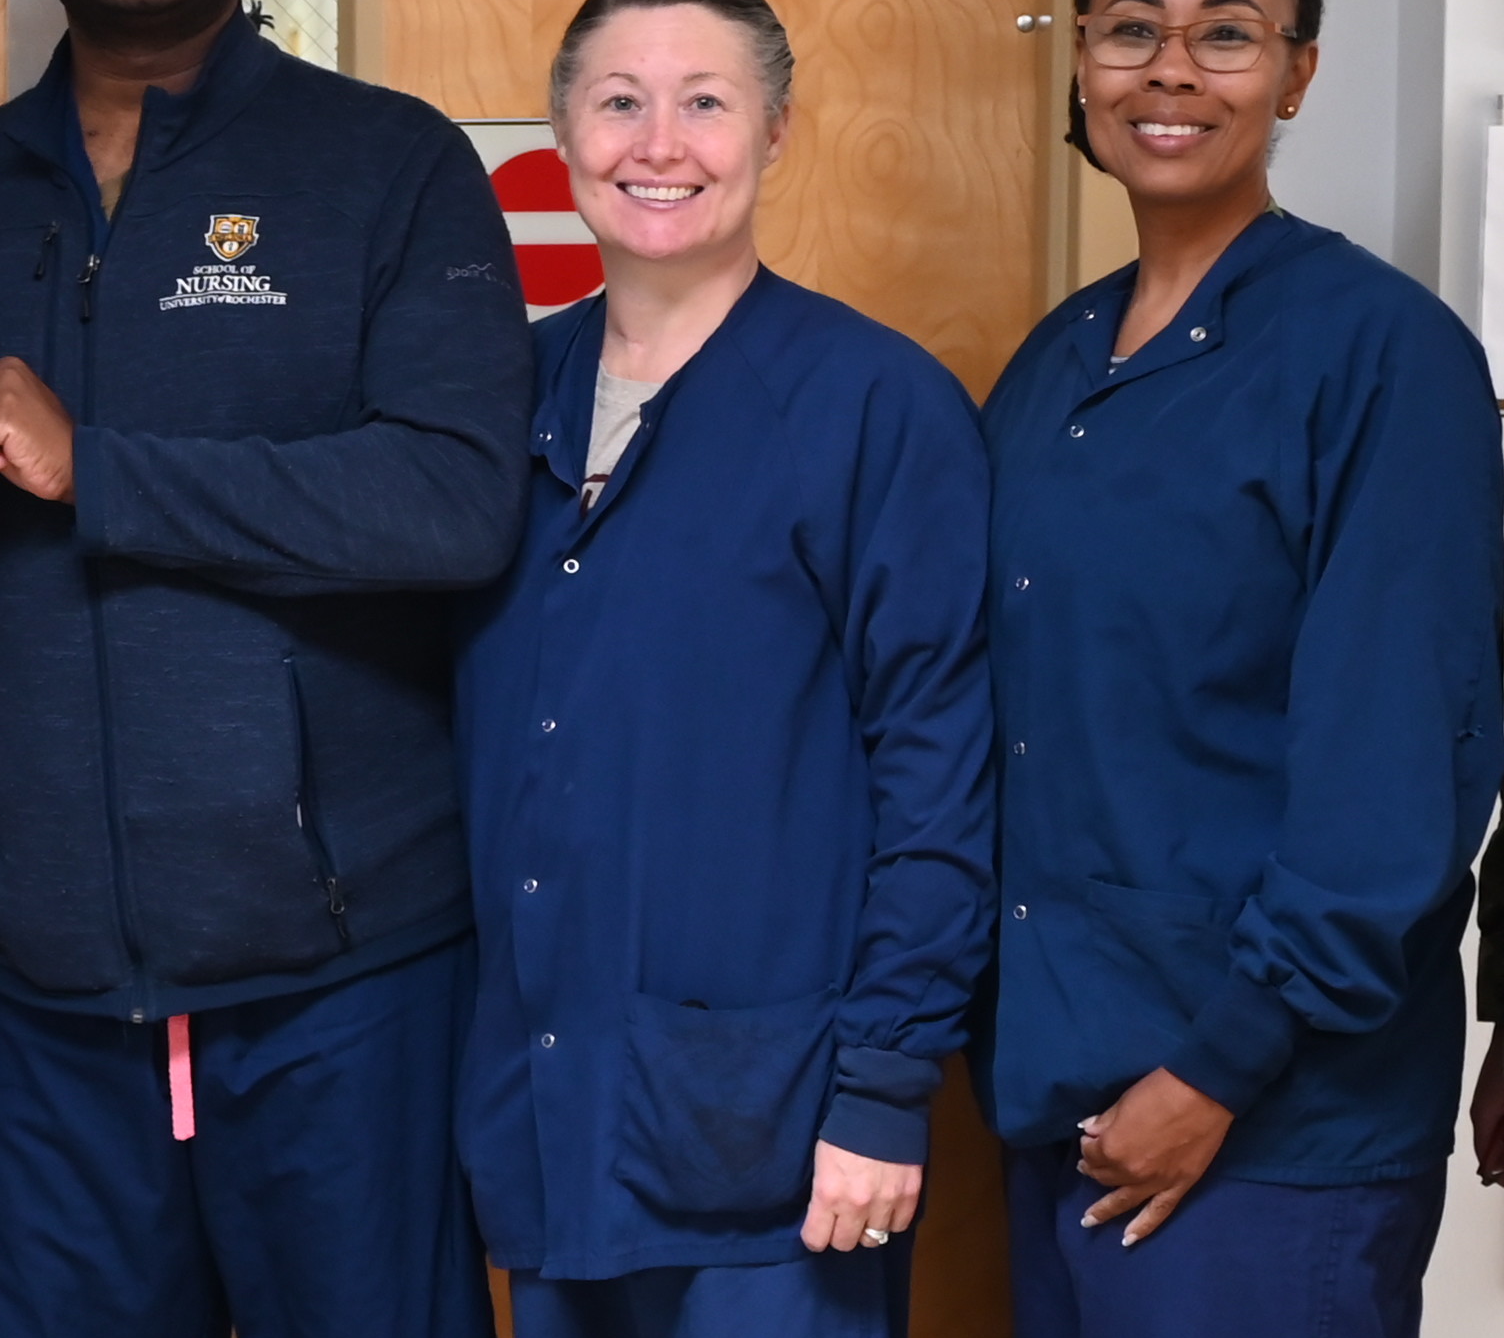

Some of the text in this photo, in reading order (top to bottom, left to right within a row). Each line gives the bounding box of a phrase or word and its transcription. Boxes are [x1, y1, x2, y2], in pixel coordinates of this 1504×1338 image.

[193, 265, 256, 275] SCHOOL OF
[176, 275, 271, 295] NURSING
